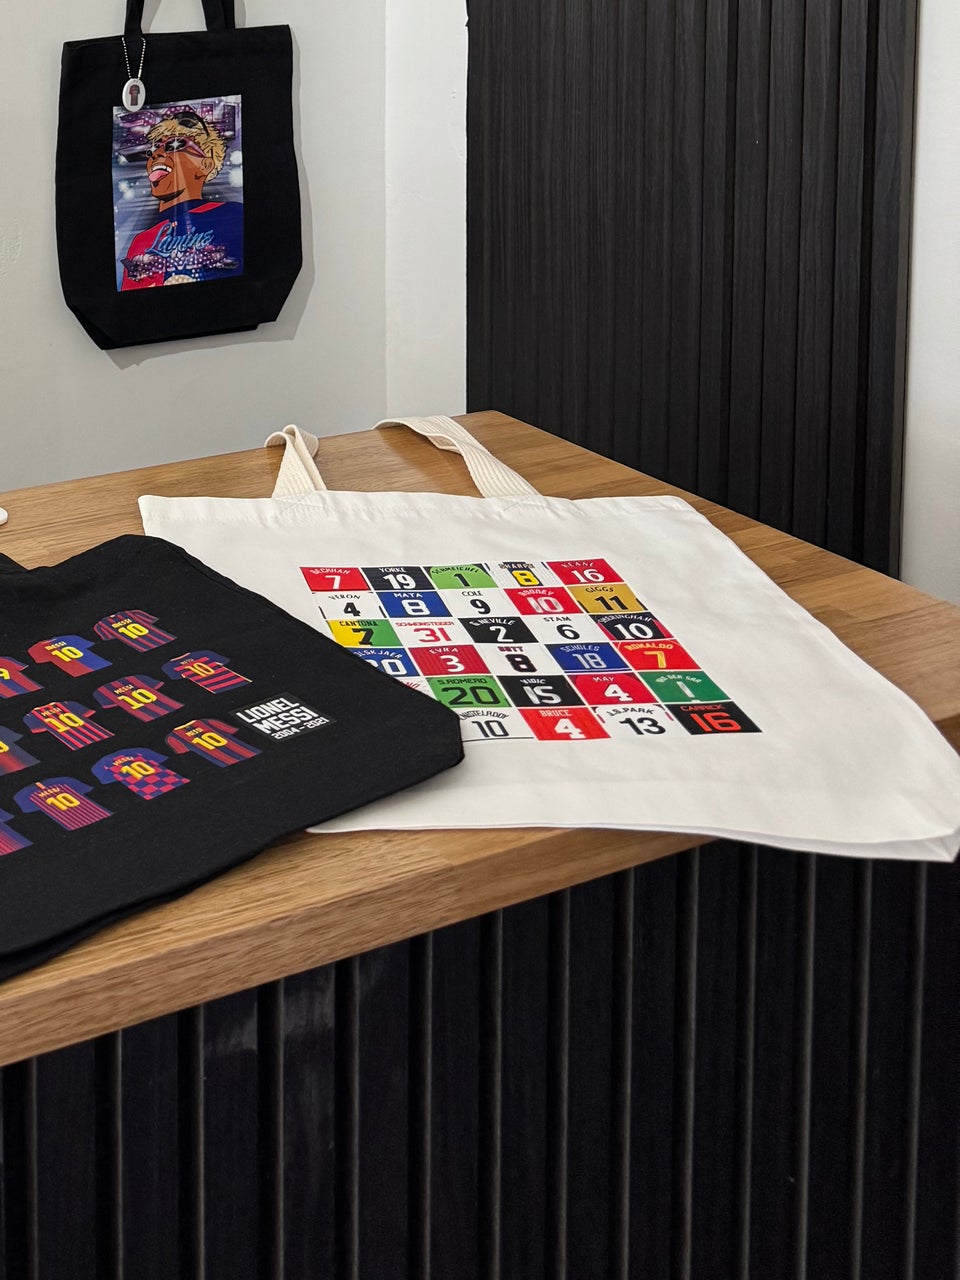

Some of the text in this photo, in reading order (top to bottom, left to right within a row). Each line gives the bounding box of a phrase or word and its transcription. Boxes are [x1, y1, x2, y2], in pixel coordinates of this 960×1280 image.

[325, 575, 341, 589] 7
[382, 573, 416, 589] 19
[453, 573, 471, 587] 1
[511, 570, 540, 586] 8
[571, 568, 605, 583] 16
[343, 602, 361, 616] 4
[401, 599, 430, 616] 8
[470, 598, 491, 615] 9
[526, 596, 565, 613] 10
[594, 595, 628, 610] 11
[118, 623, 149, 639] 10
[352, 628, 374, 646] 7
[413, 627, 452, 642] 31
[489, 626, 514, 642] 2
[556, 624, 580, 640] 6
[614, 622, 654, 639] 10
[51, 646, 84, 662] 10
[571, 653, 607, 669] 18
[643, 650, 667, 668] 7
[184, 662, 215, 677] 10
[440, 655, 465, 672] 3
[505, 653, 537, 673] 8
[441, 685, 501, 705] 20
[523, 685, 561, 705] 15
[604, 683, 633, 702] 4
[676, 681, 695, 698] 1
[117, 688, 158, 710] 10
[235, 697, 300, 724] LIONEL
[539, 709, 572, 717] BRUCE
[44, 712, 85, 733] 10
[252, 706, 319, 734] MESSI
[554, 718, 586, 739] 4
[619, 717, 666, 735] 13
[690, 712, 742, 732] 16
[471, 720, 510, 738] 10
[191, 732, 228, 751] 10
[121, 761, 155, 780] 10
[46, 792, 80, 811] 10
